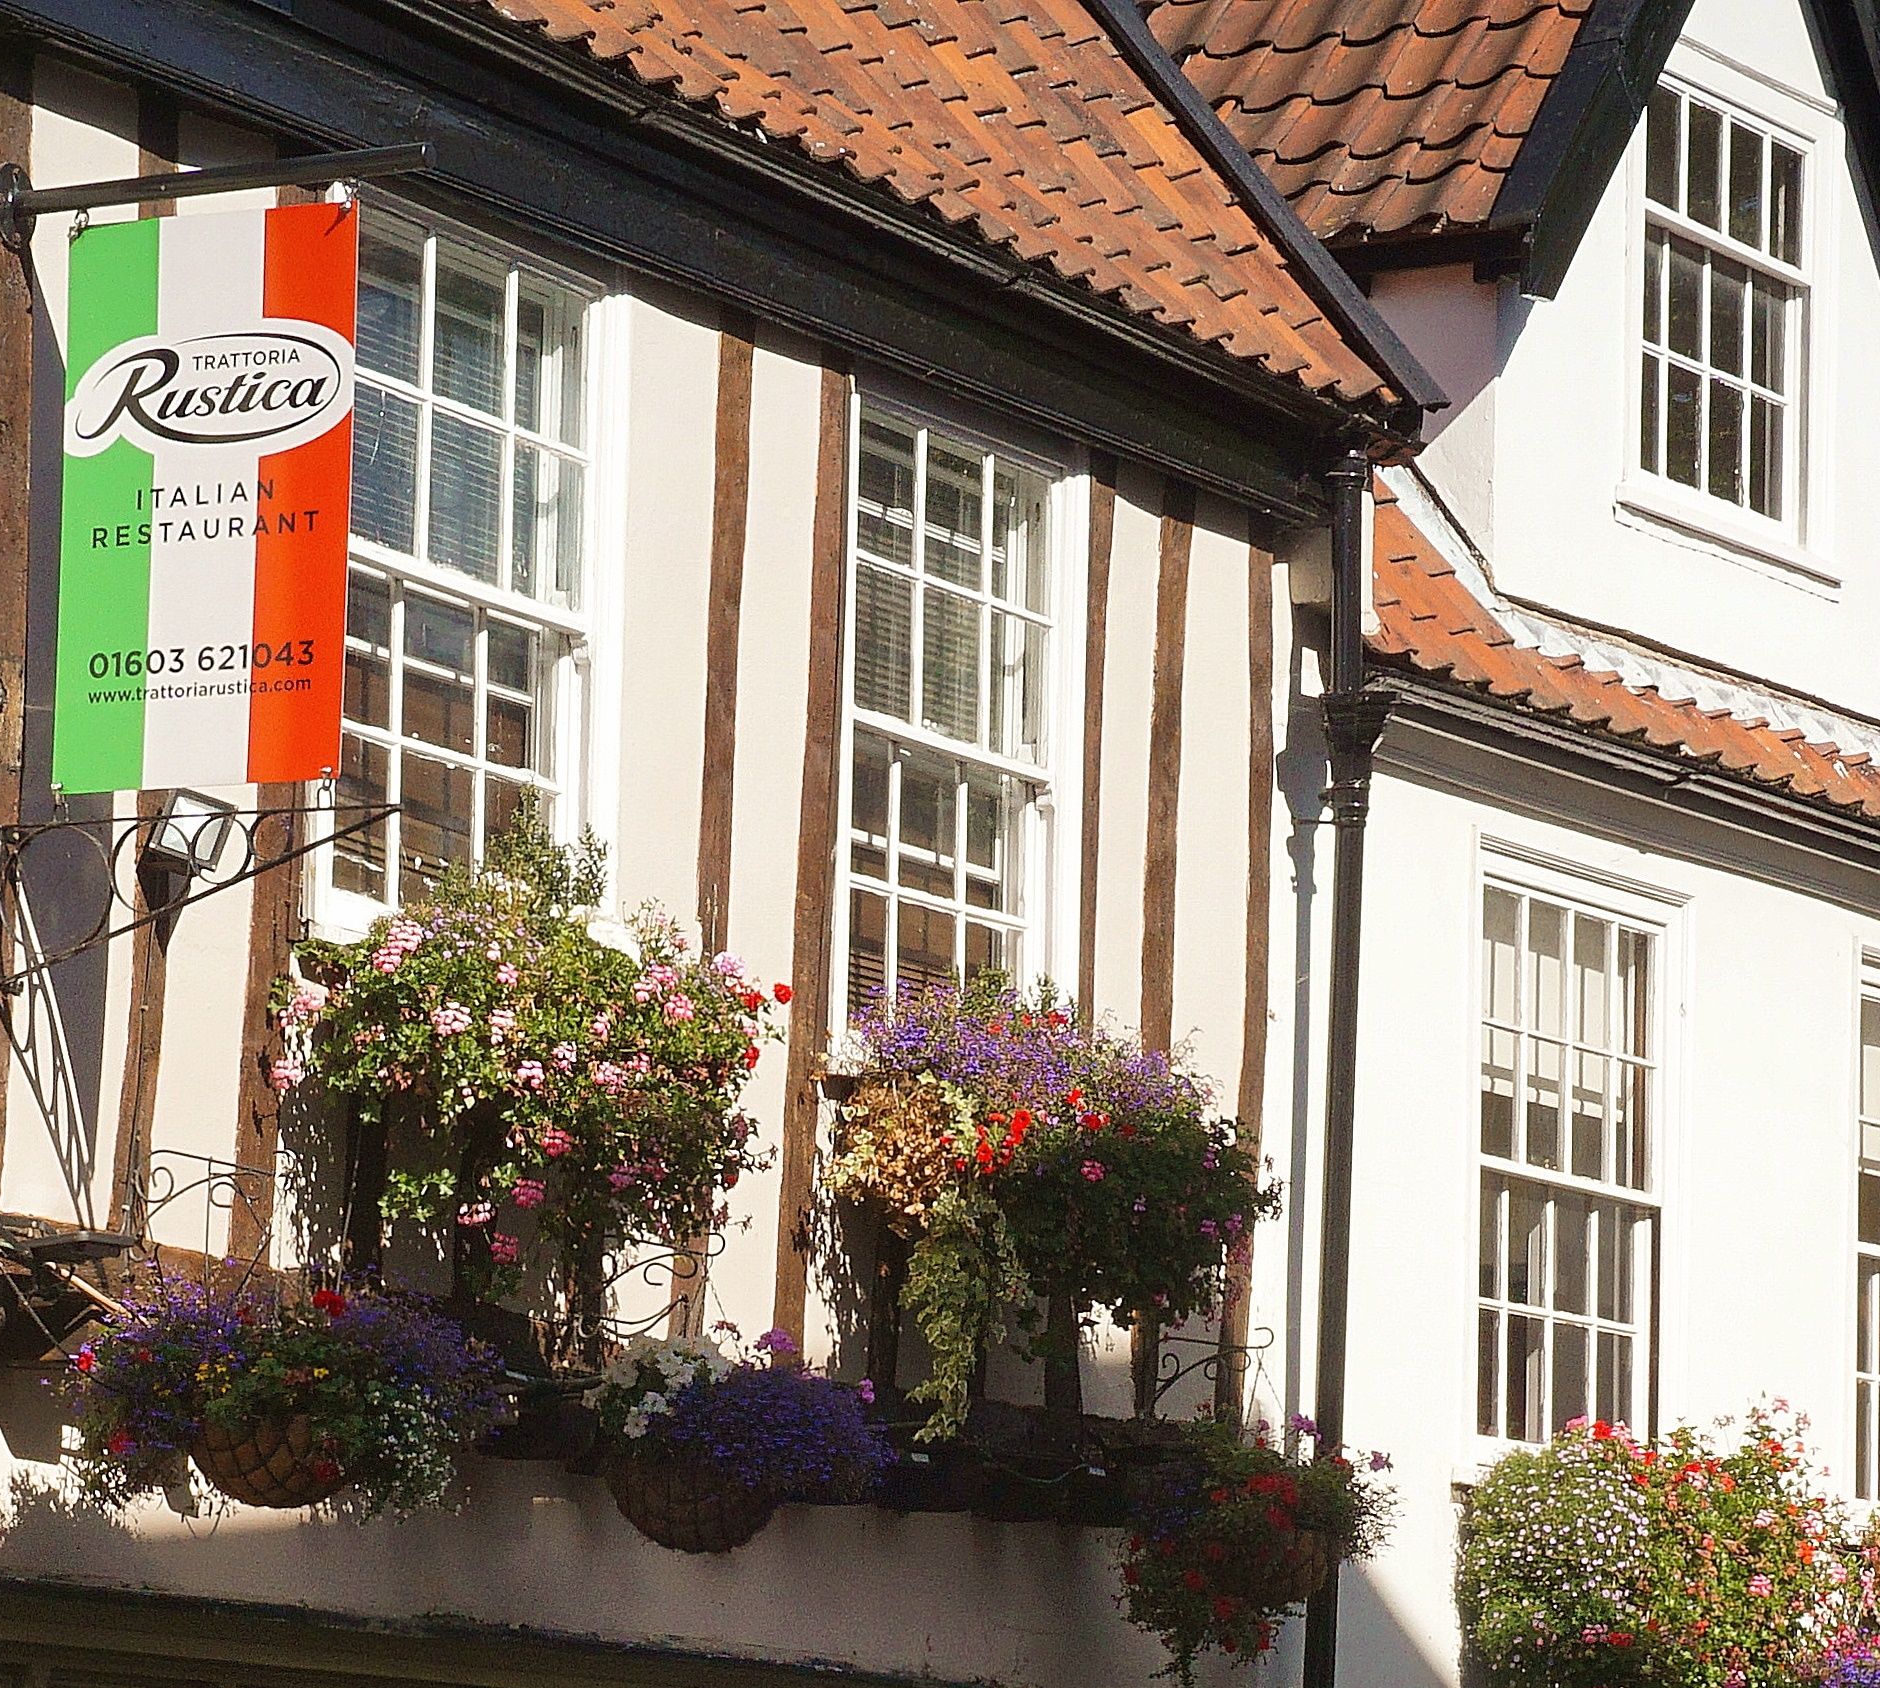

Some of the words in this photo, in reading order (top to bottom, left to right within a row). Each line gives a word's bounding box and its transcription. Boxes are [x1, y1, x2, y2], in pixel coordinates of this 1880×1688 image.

[192, 348, 301, 371] TRATTORIA
[75, 348, 328, 440] Rustica
[136, 479, 274, 510] ITALIAN
[91, 511, 319, 549] RESTAURANT
[89, 648, 185, 679] 01603
[198, 640, 314, 671] 621043
[88, 678, 311, 704] www.trattoriarustica.com
